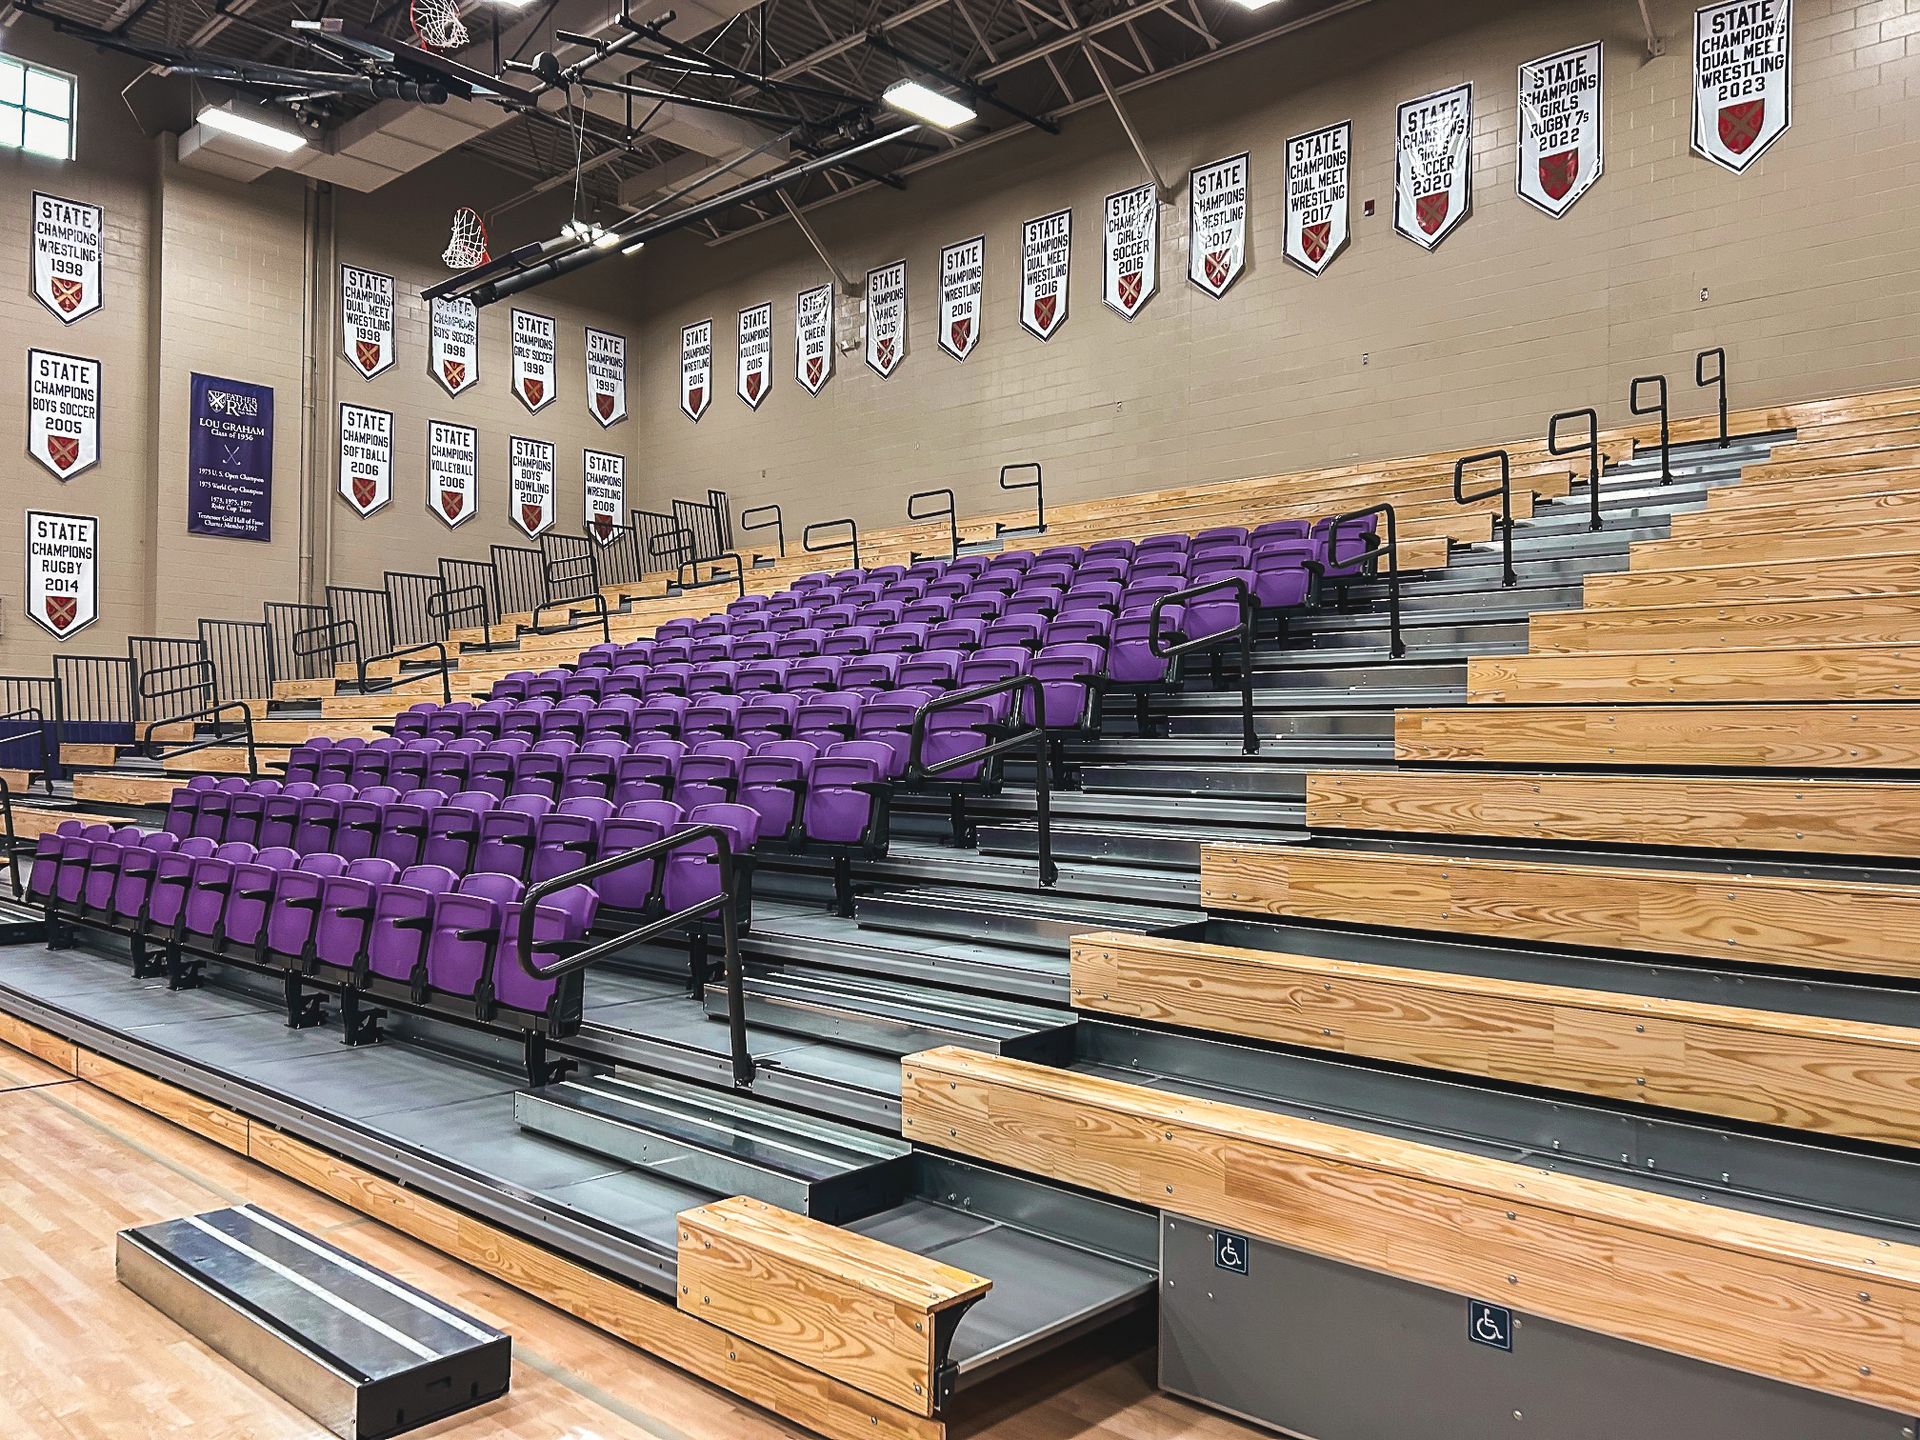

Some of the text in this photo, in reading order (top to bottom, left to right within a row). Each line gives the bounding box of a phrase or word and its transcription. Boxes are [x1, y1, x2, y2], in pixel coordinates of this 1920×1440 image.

[1712, 0, 1774, 34] STATE
[1702, 18, 1785, 54] CHAMPIONS
[1703, 36, 1784, 72] DUAL MEET
[1534, 55, 1587, 89] STATE
[1702, 54, 1784, 89] WRESTLING
[1719, 76, 1765, 101] 2023
[1540, 95, 1578, 118] GIRLS
[1531, 110, 1589, 138] RUGBY 7s
[1403, 119, 1464, 150] CHAMPNS
[1540, 128, 1579, 152] 2022
[1296, 130, 1341, 161] STATE
[1291, 150, 1346, 179] CHAMPIONS
[1199, 165, 1240, 194] STATE
[1292, 168, 1344, 195] DUAL MEET
[1413, 173, 1451, 196] 2020
[1113, 189, 1150, 216] STATE
[1291, 184, 1344, 212] WRESTLING
[42, 201, 91, 228] STATE
[1303, 204, 1332, 225] 2017
[37, 222, 97, 246] CHAMPIONS
[1030, 216, 1064, 241] STATE
[1027, 234, 1068, 257] CHAMPIONS
[1205, 228, 1232, 249] 2017
[38, 238, 96, 262] WRESTLING
[948, 246, 978, 270] STATE
[1113, 239, 1149, 261] SOCCER
[51, 258, 83, 277] 1998
[1028, 249, 1066, 271] DUAL MEET
[1119, 256, 1143, 274] 2016
[349, 271, 387, 294] STATE
[873, 269, 900, 291] STATE
[944, 266, 981, 287] CHAMPIONS
[1027, 264, 1066, 285] WRESTLING
[345, 286, 391, 307] CHAMPIONS
[871, 288, 903, 306] HAMPIONS
[945, 282, 980, 302] WRESTLING
[1035, 280, 1057, 297] 2016
[346, 299, 389, 319] DUAL MEET
[803, 291, 828, 312] STA
[952, 301, 972, 317] 2016
[346, 312, 390, 331] WRESTLING
[518, 316, 549, 336] STATE
[744, 310, 767, 330] STATE
[877, 321, 895, 336] 2015
[356, 327, 381, 342] 1998
[452, 331, 475, 345] SOCCER
[515, 332, 553, 350] CHAMPIONS
[686, 327, 708, 346] STATE
[741, 327, 769, 344] CHAMPIONS
[805, 326, 825, 341] CHEER
[443, 343, 466, 357] 1998
[591, 335, 620, 354] STATE
[684, 344, 710, 360] CHAMPIONS
[806, 341, 823, 355] 2015
[532, 350, 552, 364] SOCCER
[588, 351, 623, 368] CHAMPIONS
[684, 357, 709, 373] WRESTLING
[747, 357, 762, 370] 2015
[40, 359, 89, 384] STATE
[524, 362, 544, 375] 1998
[588, 364, 622, 381] VOLLEYBALL
[596, 379, 615, 392] 1999
[689, 373, 703, 386] 2015
[34, 380, 94, 402] CHAMPIONS
[226, 393, 257, 404] FATHER
[33, 397, 95, 419] BOYS SOCCER
[45, 417, 82, 434] 2005
[199, 418, 265, 436] LOU GRAHAM
[348, 411, 385, 432] STATE
[211, 428, 227, 437] Class
[343, 429, 388, 448] CHAMPIONS
[436, 428, 470, 447] STATE
[343, 445, 387, 462] SOFTBALL
[432, 445, 473, 462] CHAMPIONS
[517, 441, 548, 459] STATE
[351, 462, 378, 476] 2006
[432, 459, 473, 476] VOLLEYBALL
[513, 456, 551, 472] CHAMPIONS
[590, 456, 618, 473] STATE
[224, 472, 239, 480] Open
[440, 475, 464, 489] 2006
[587, 472, 621, 487] CHAMPIONS
[227, 485, 238, 494] Cup
[515, 479, 549, 494] BOWLING
[587, 486, 620, 500] WRESTLING
[521, 492, 543, 504] 2007
[593, 500, 614, 512] 2008
[38, 521, 88, 542] STATE
[32, 542, 92, 559] CHAMPIONS
[42, 559, 82, 575] RUGBY
[45, 578, 78, 593] 2014
